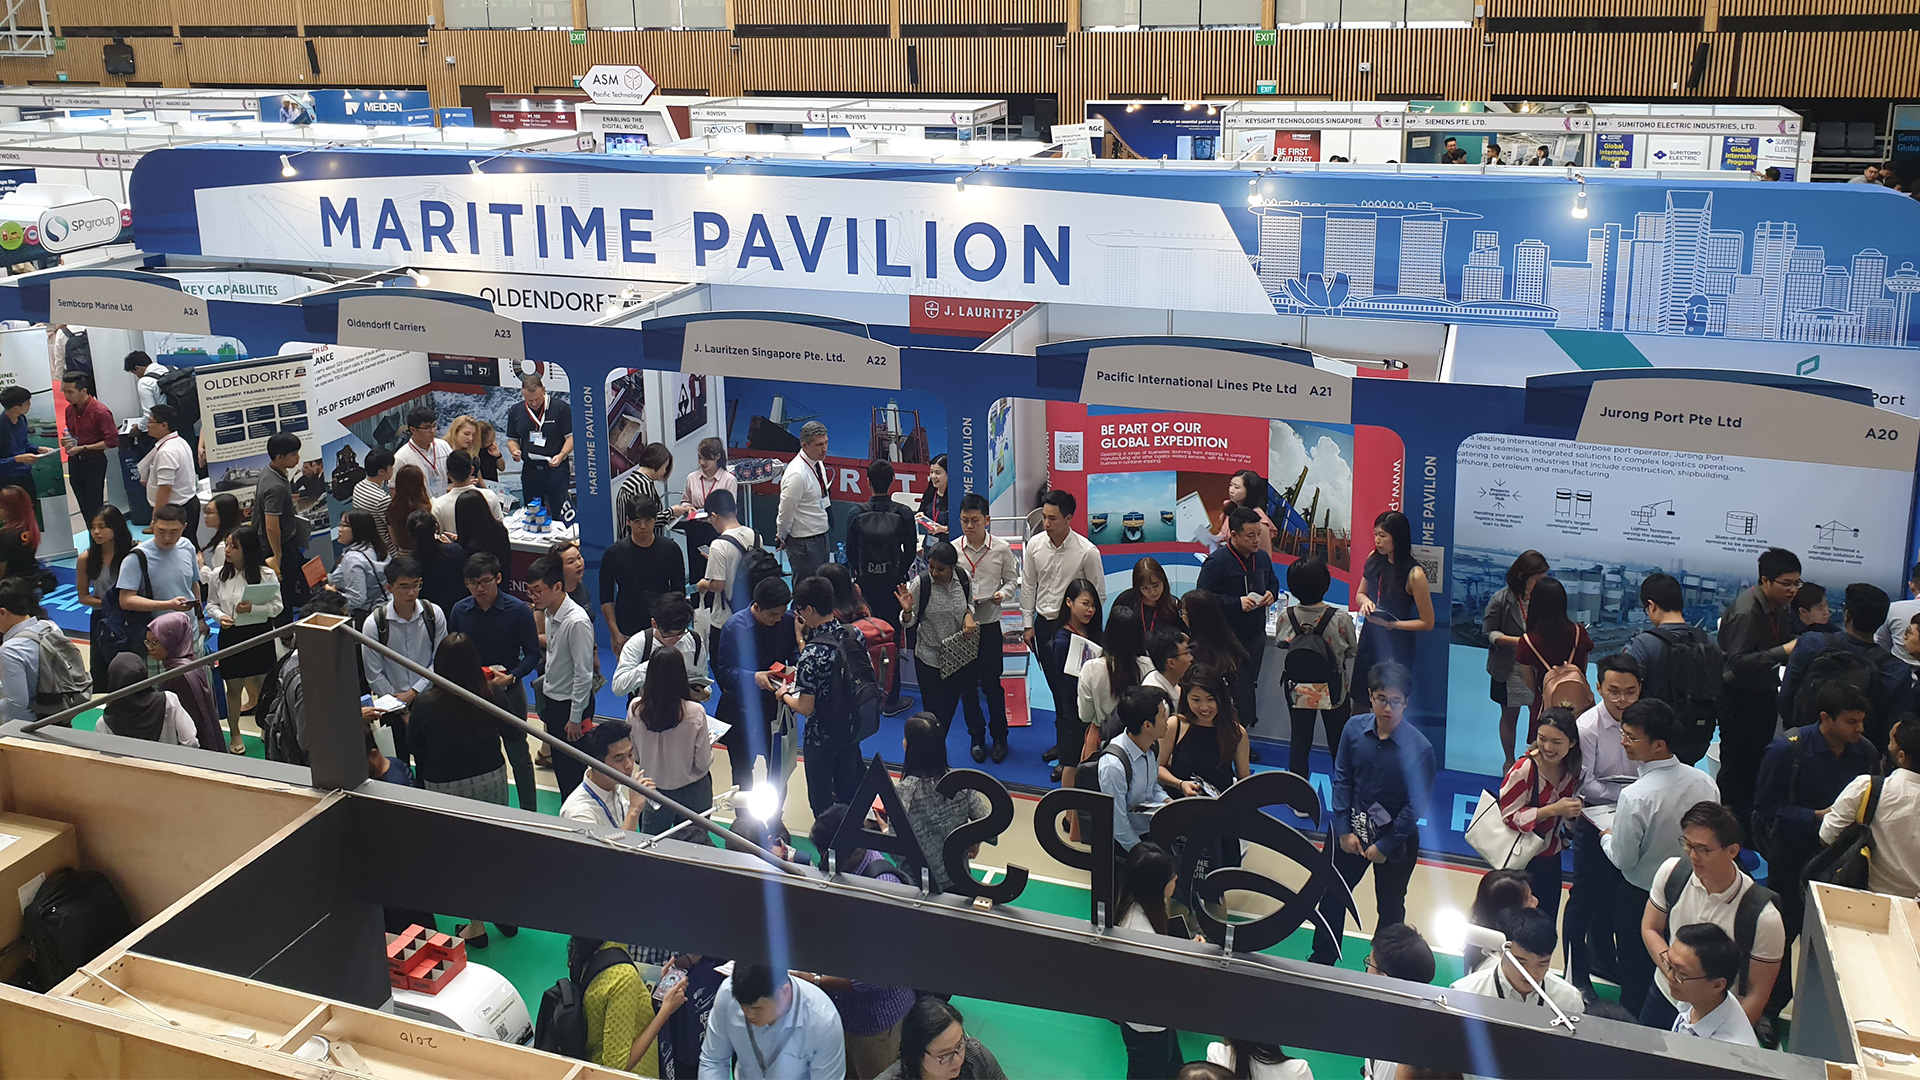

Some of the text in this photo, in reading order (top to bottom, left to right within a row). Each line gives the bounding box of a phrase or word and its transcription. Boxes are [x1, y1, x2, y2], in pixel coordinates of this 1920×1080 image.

[571, 33, 585, 41] EXIT
[1255, 32, 1275, 41] EXIT
[593, 74, 619, 85] ASM
[612, 91, 643, 100] Technology
[364, 102, 402, 112] MEIDEN
[704, 126, 744, 134] ROVISYS
[1693, 122, 1739, 130] INDUSTRIES,
[1898, 134, 1920, 142] Germ
[1277, 148, 1309, 156] BE FIRST
[72, 215, 116, 231] SPgroup
[319, 196, 1070, 286] MARITIME PAVILION
[183, 285, 278, 296] KEY CAPABILITIES
[58, 298, 198, 316] Sembcorp Marine Ltd A24
[944, 306, 1026, 320] J. LAURITZE
[347, 318, 512, 338] Oldendorff Carriers A23
[314, 352, 334, 366] ANCE
[694, 344, 887, 366] J. Lauritzen Singapore Pte. Ltd. A22
[204, 368, 292, 391] OLDENDORFF
[1096, 370, 1332, 397] Pacific International Lines Pte Ltd A21
[206, 392, 242, 401] OLDENDORFF
[266, 383, 300, 392] PROGRAMME
[328, 402, 338, 412] OF
[339, 391, 366, 408] STEADY
[366, 380, 396, 398] GROWTH
[1100, 422, 1202, 436] BE PART OF OUR
[1600, 406, 1898, 441] Jurong Port Pte Ltd A20
[584, 386, 598, 496] MARITIME PAVILION
[1100, 436, 1228, 449] GLOBAL EXPEDITION
[1476, 434, 1505, 444] leading
[1508, 438, 1556, 448] international
[1558, 442, 1612, 452] multipurpose
[1614, 446, 1631, 454] port
[1634, 448, 1672, 458] operator,
[1674, 451, 1704, 460] Jurong
[962, 417, 974, 496] IME PAVILION
[1457, 450, 1488, 460] catering
[1501, 454, 1530, 462] various
[1532, 456, 1570, 466] industries
[1572, 460, 1588, 468] that
[1590, 462, 1620, 470] include
[1622, 465, 1676, 476] construction,
[1459, 442, 1490, 451] provides
[1492, 445, 1530, 454] seamless,
[1532, 448, 1574, 458] integrated
[1575, 452, 1611, 460] solutions
[1624, 456, 1660, 466] complex
[1662, 460, 1696, 468] logistics
[1698, 463, 1746, 473] operations,
[1456, 459, 1490, 468] offshore,
[1492, 462, 1532, 471] petroleum
[1552, 468, 1610, 478] manufacturing
[1422, 456, 1438, 545] IME PAVILION
[1647, 538, 1676, 546] anchorages
[1714, 534, 1755, 543] State-of-the-art
[867, 561, 888, 574] CAT
